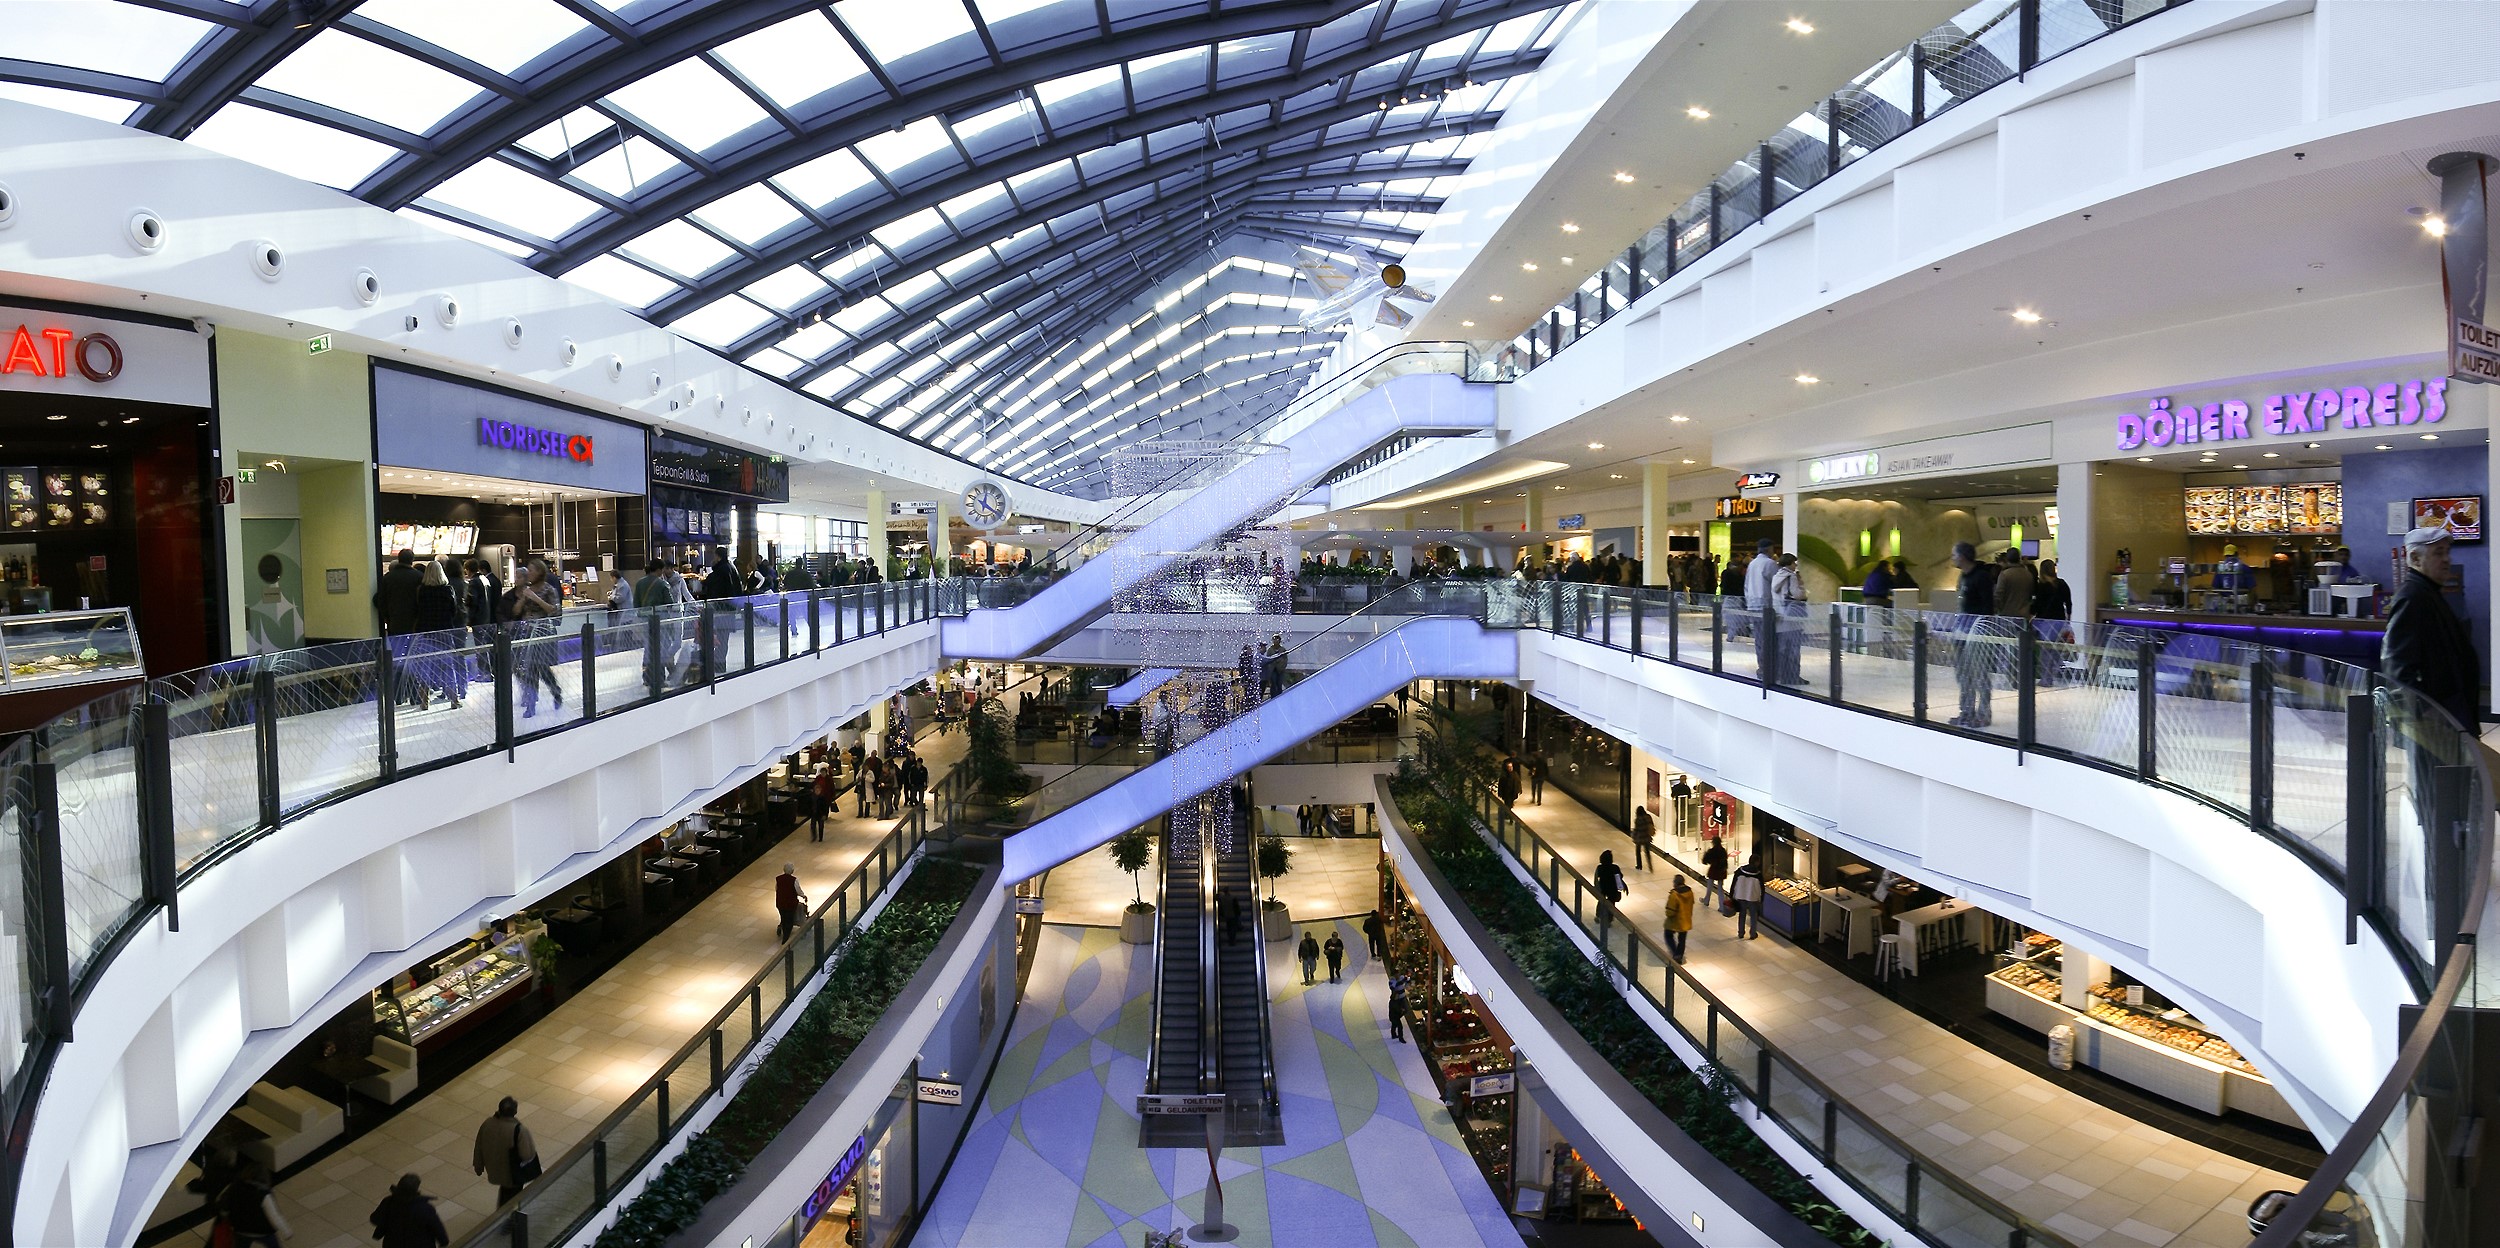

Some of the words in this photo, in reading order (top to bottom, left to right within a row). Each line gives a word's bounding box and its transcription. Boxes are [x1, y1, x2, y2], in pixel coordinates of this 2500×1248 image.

[0, 323, 123, 383] ATO
[2461, 352, 2500, 377] AUFZU
[480, 417, 568, 459] NORDSEE
[2117, 397, 2250, 450] DÖNER
[2263, 376, 2447, 435] EXPRESS
[919, 1086, 959, 1097] COSMO
[806, 1135, 865, 1218] COSMO
